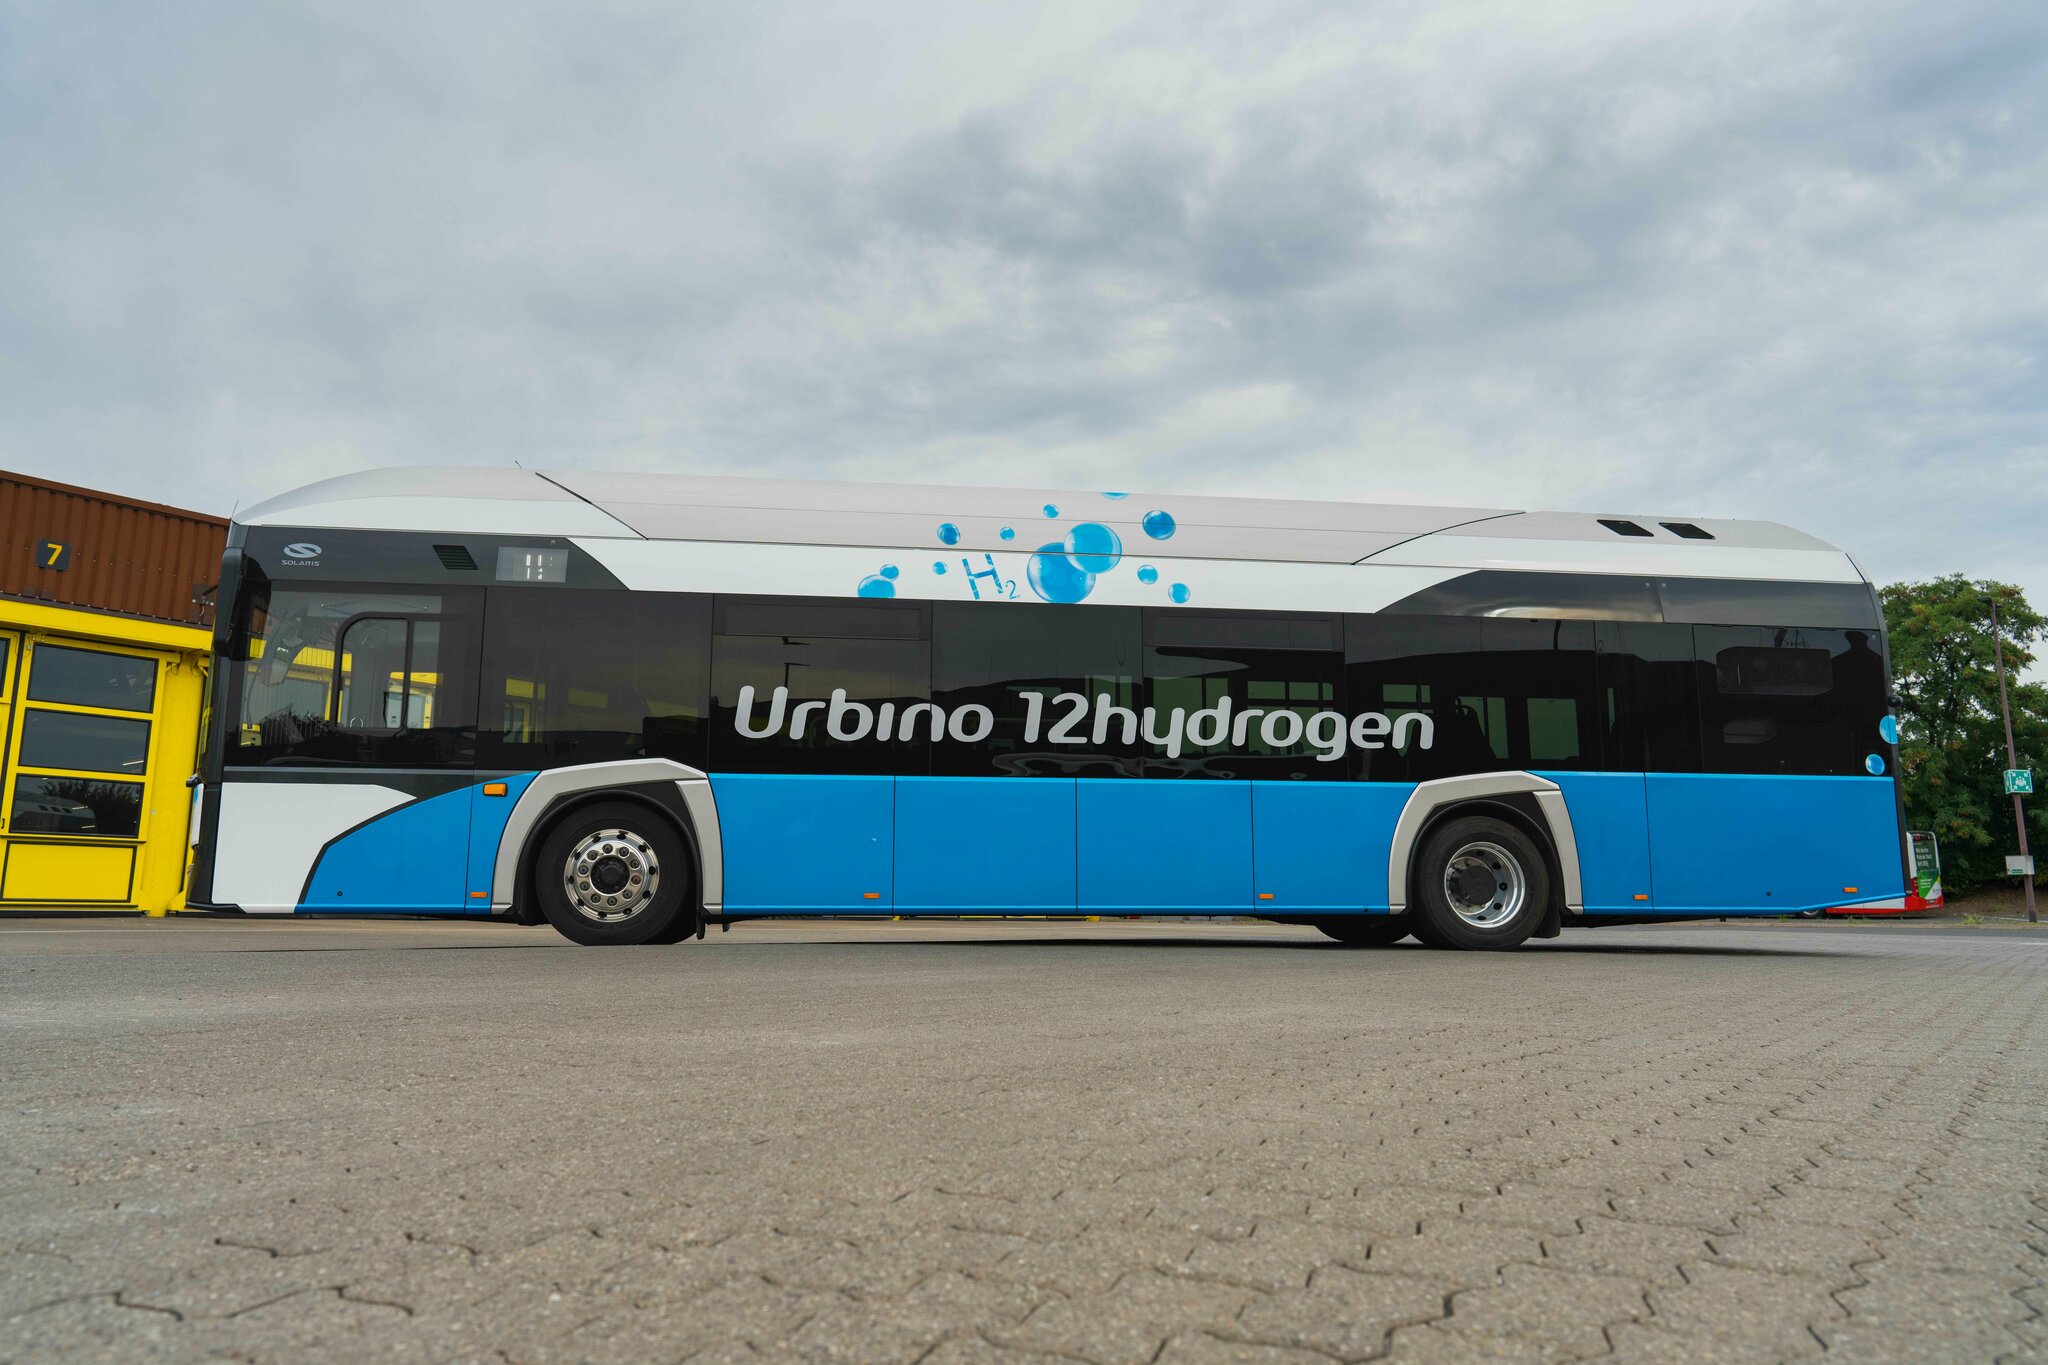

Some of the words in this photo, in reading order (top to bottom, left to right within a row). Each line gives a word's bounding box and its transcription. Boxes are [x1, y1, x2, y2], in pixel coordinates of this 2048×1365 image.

[47, 542, 63, 566] 7
[281, 559, 320, 567] SOLARIS
[734, 685, 994, 742] Urbino
[1019, 691, 1434, 762] 12hydrogen
